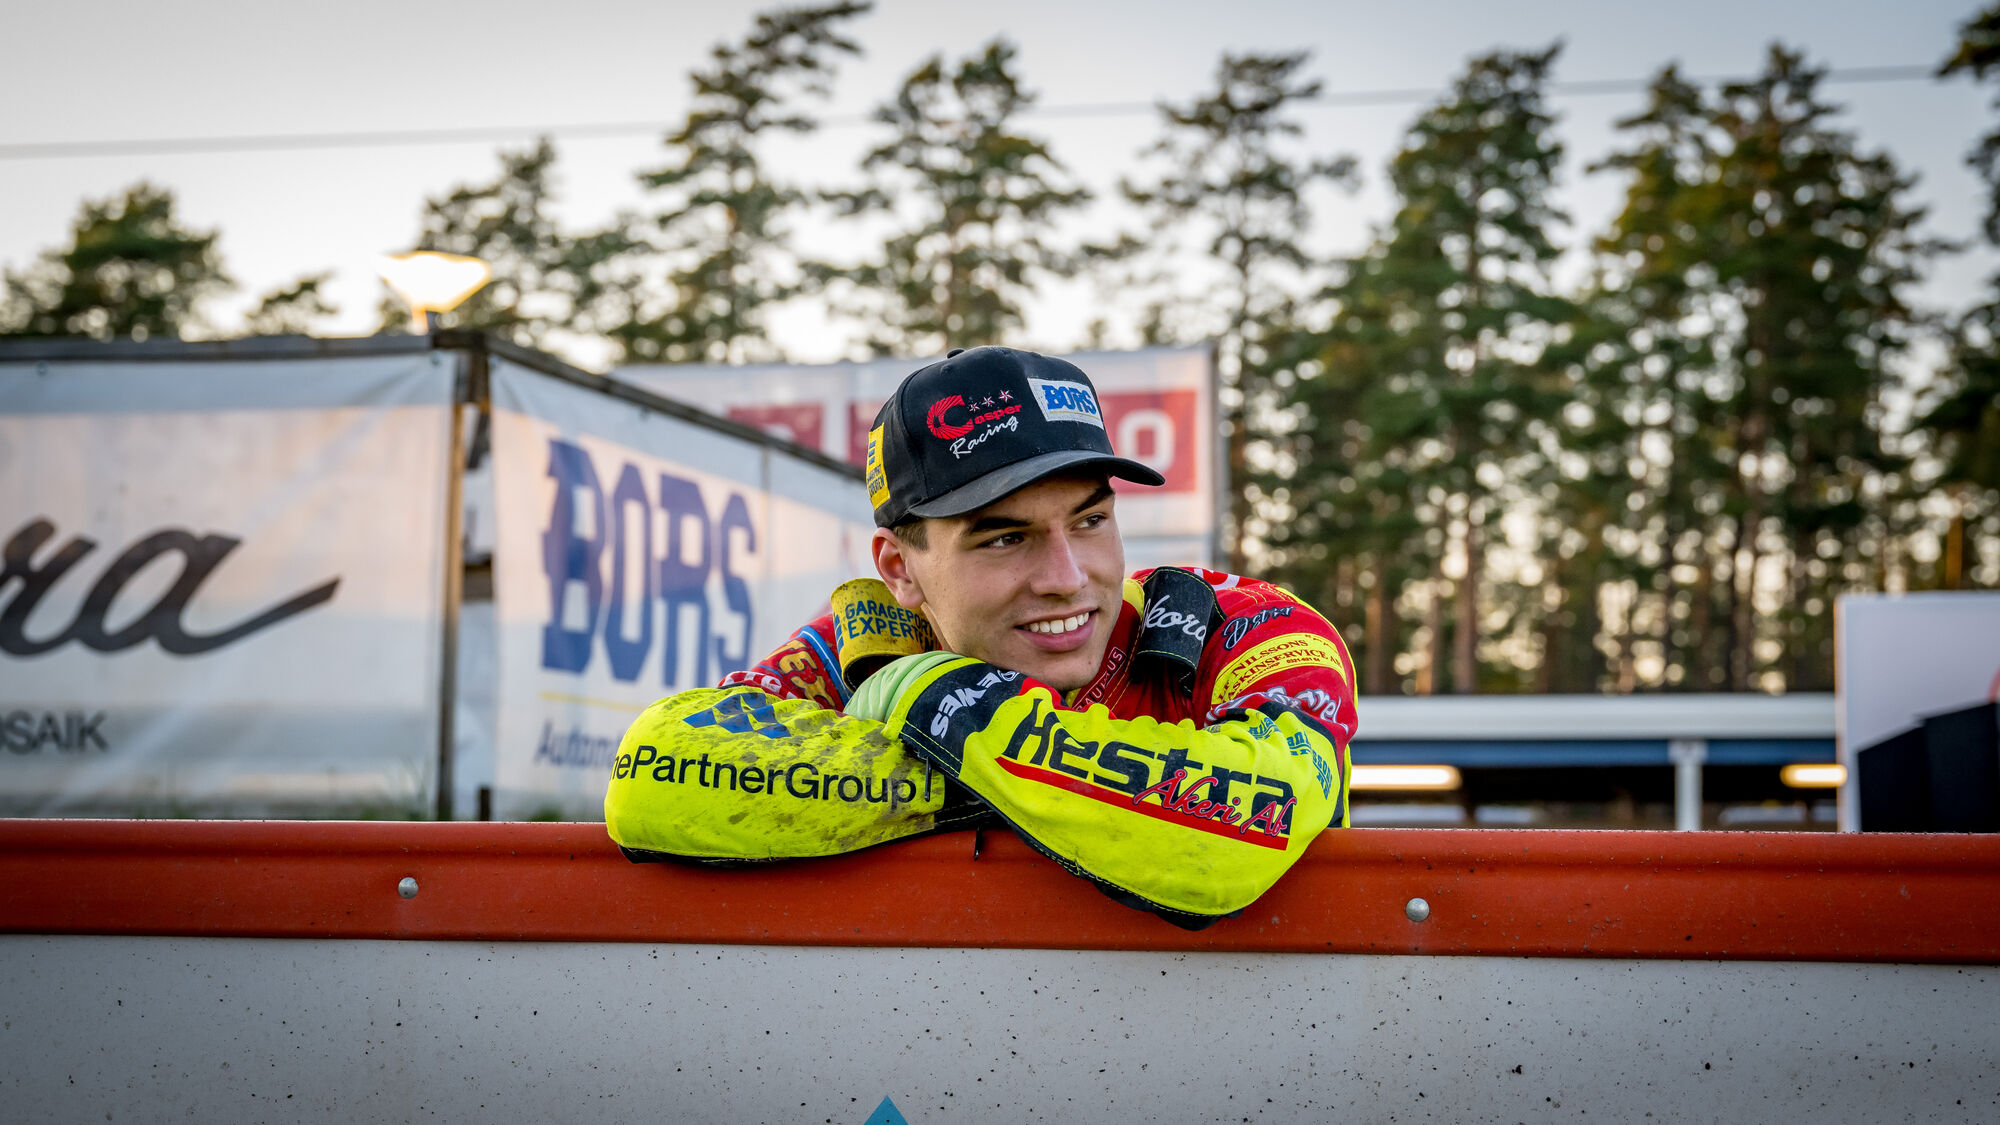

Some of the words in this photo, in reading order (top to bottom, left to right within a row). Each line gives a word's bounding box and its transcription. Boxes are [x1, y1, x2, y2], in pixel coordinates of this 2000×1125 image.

[926, 394, 1022, 440] Casper
[1041, 384, 1098, 416] BORS
[950, 415, 1018, 459] Racing
[542, 438, 757, 688] BORS
[1232, 639, 1309, 678] NILSSONS
[0, 710, 109, 755] SAIK
[1003, 699, 1294, 836] Hestra
[1133, 769, 1242, 824] Åkeri
